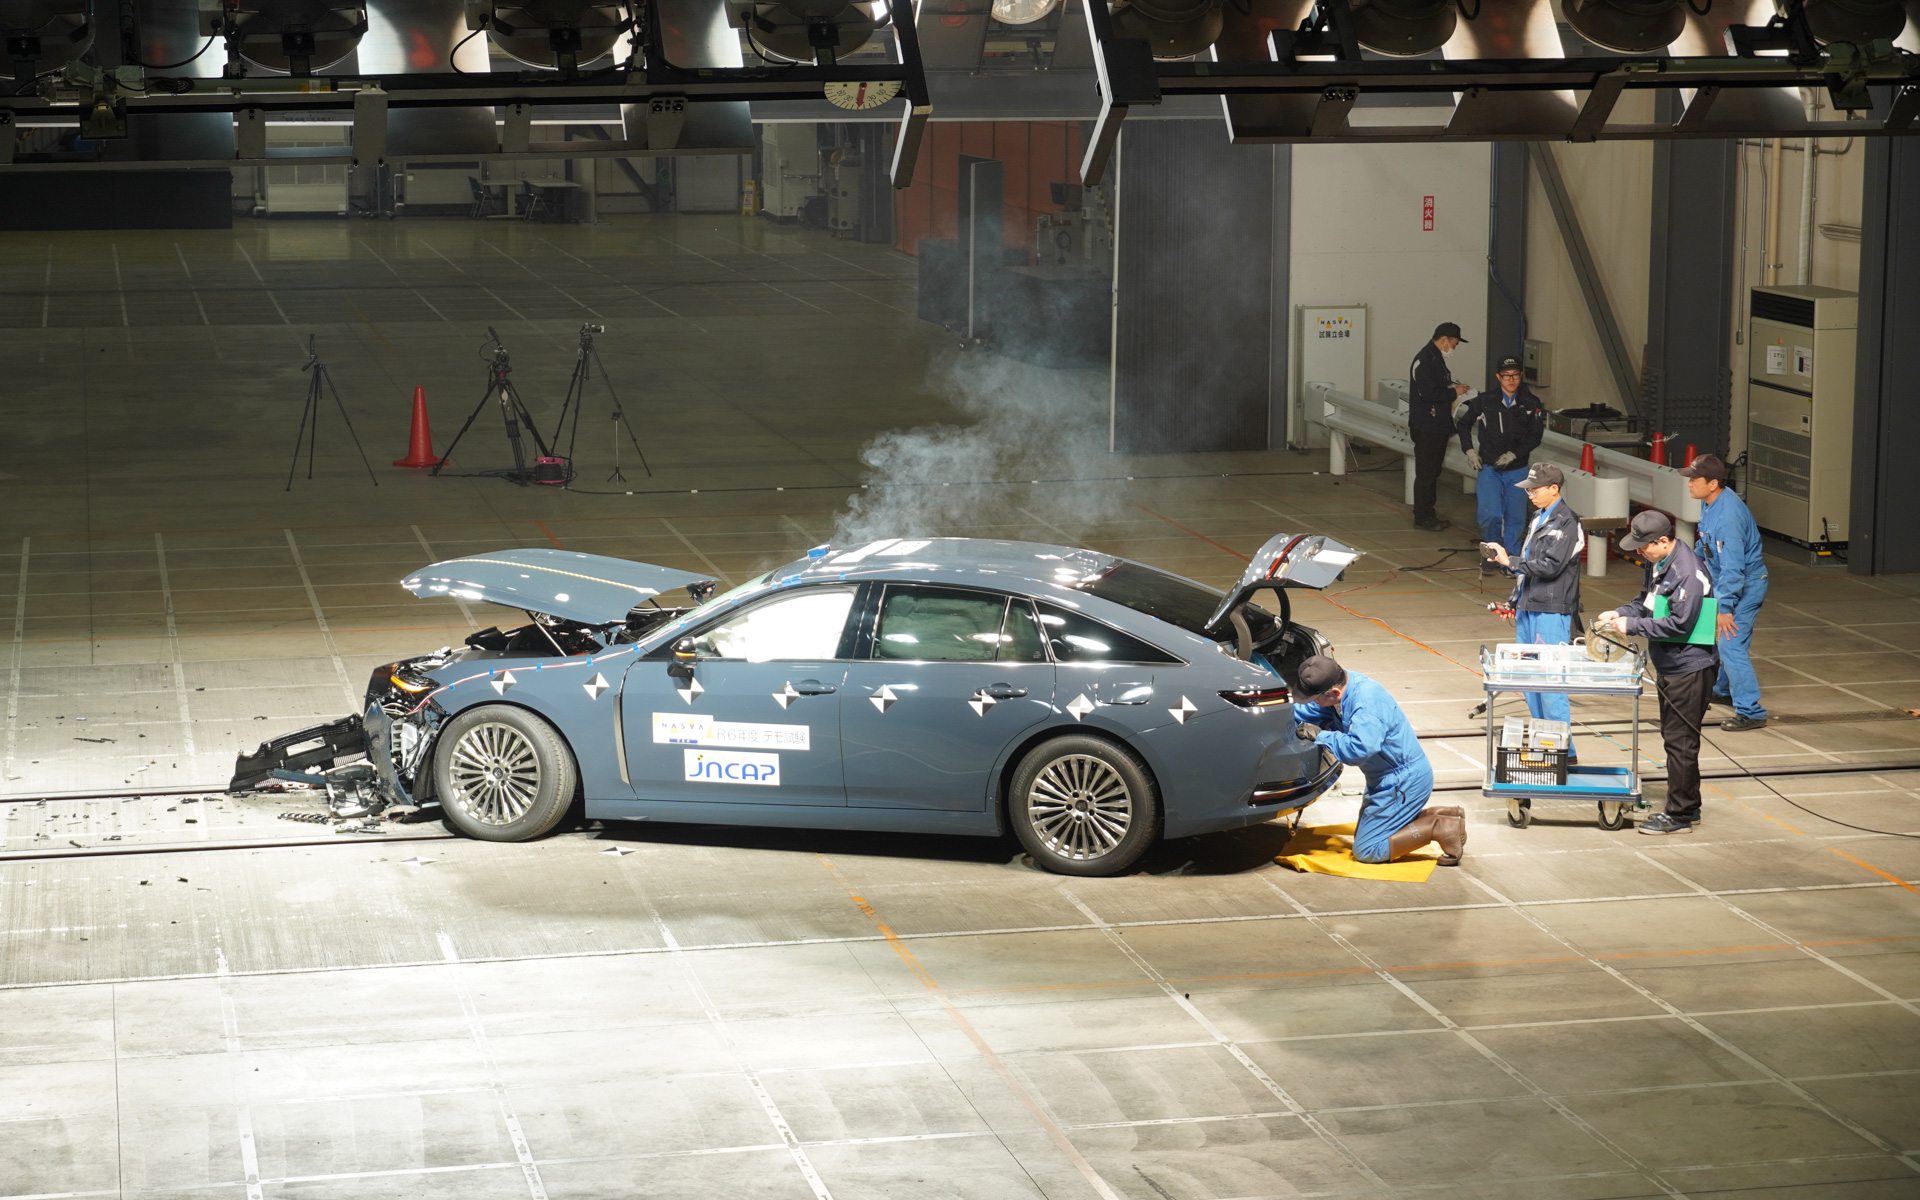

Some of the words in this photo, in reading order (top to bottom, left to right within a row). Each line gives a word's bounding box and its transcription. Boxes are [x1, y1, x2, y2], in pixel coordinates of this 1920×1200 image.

[1424, 197, 1433, 230] 消火器
[661, 722, 704, 731] NASVA
[717, 727, 759, 743] R6年度
[763, 730, 806, 745] デモ試験
